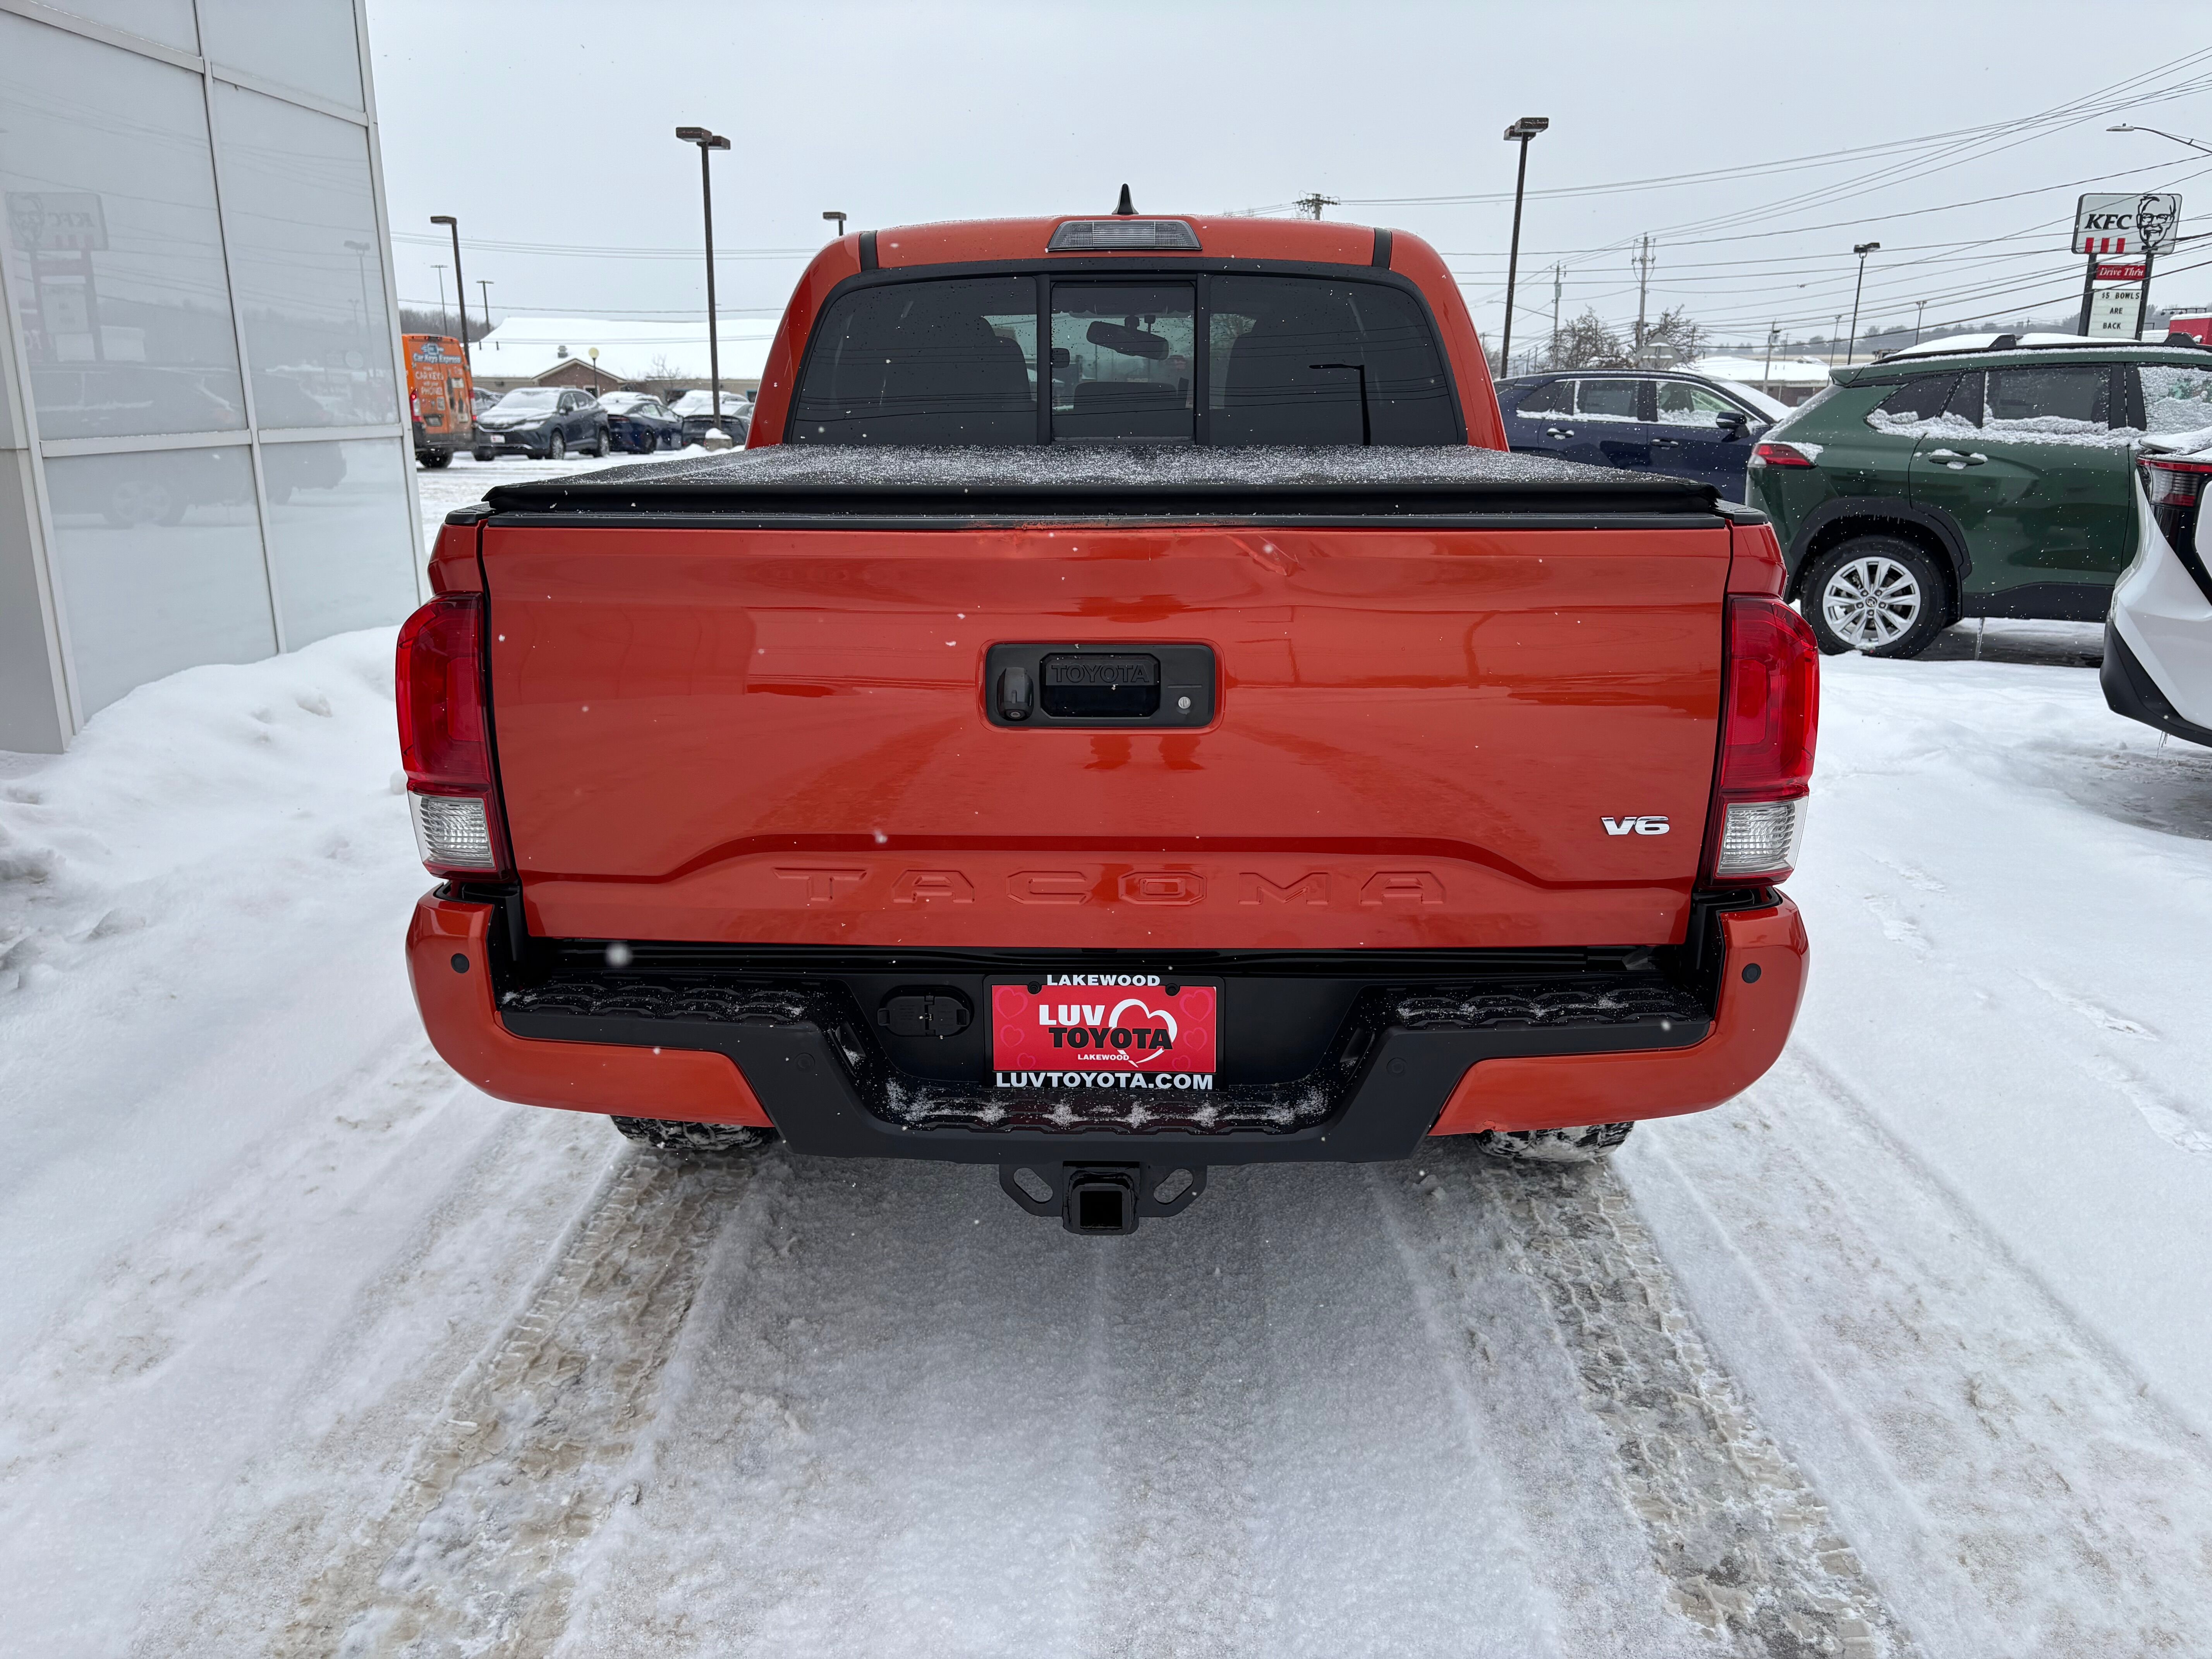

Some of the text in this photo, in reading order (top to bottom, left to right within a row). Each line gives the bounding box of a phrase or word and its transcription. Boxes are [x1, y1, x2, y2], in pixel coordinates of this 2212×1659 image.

[2084, 214, 2133, 230] KFC
[2099, 267, 2143, 276] Drive Thru
[413, 353, 461, 364] Car Keys Express
[415, 371, 428, 380] CAR
[429, 372, 444, 380] KEYS
[1051, 665, 1150, 683] TOYOTA
[1601, 816, 1669, 835] V6
[773, 867, 1446, 906] TACOMA
[1047, 975, 1160, 986] LAKEWOOD
[1039, 1005, 1105, 1025] LUV
[1048, 1027, 1173, 1049] TOYOTA
[996, 1072, 1212, 1090] LUVTOYOTA.COM
